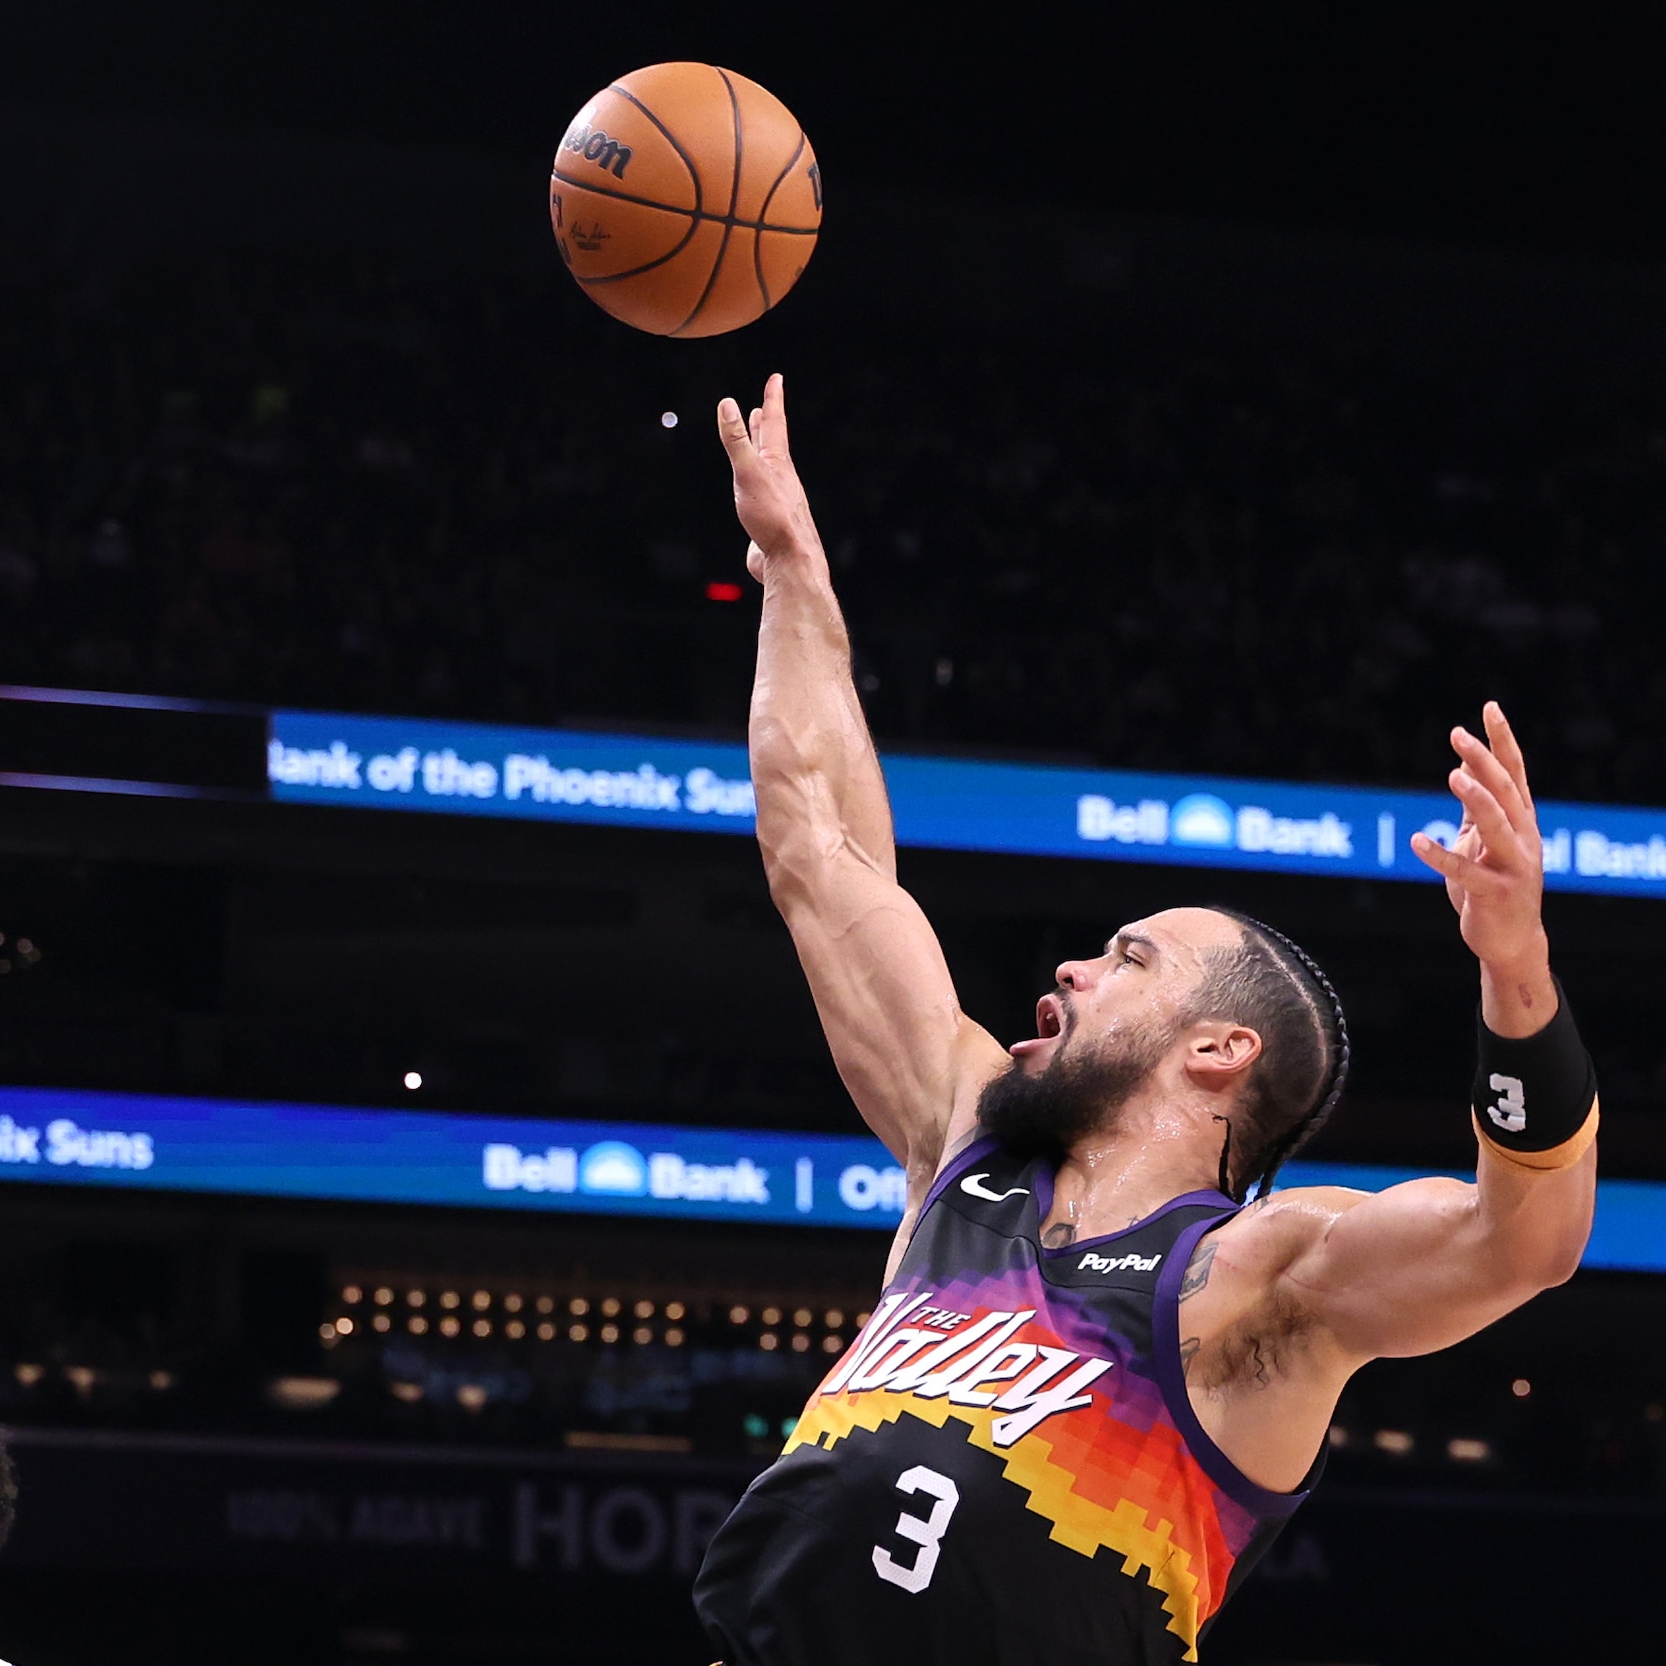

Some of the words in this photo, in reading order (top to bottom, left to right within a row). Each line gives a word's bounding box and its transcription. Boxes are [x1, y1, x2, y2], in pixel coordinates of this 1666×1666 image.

[368, 750, 418, 790] of
[423, 753, 497, 797] the
[505, 755, 678, 808] Phoenix
[1078, 796, 1169, 842] Bell
[1236, 807, 1350, 856] Bank
[1486, 1072, 1527, 1133] 3
[47, 1120, 153, 1168] Suns
[484, 1145, 577, 1191] Bell
[649, 1154, 767, 1202] Bank
[1077, 1253, 1162, 1275] PayPal
[913, 1304, 971, 1331] THE
[821, 1290, 1115, 1448] Valley
[871, 1464, 961, 1595] 3
